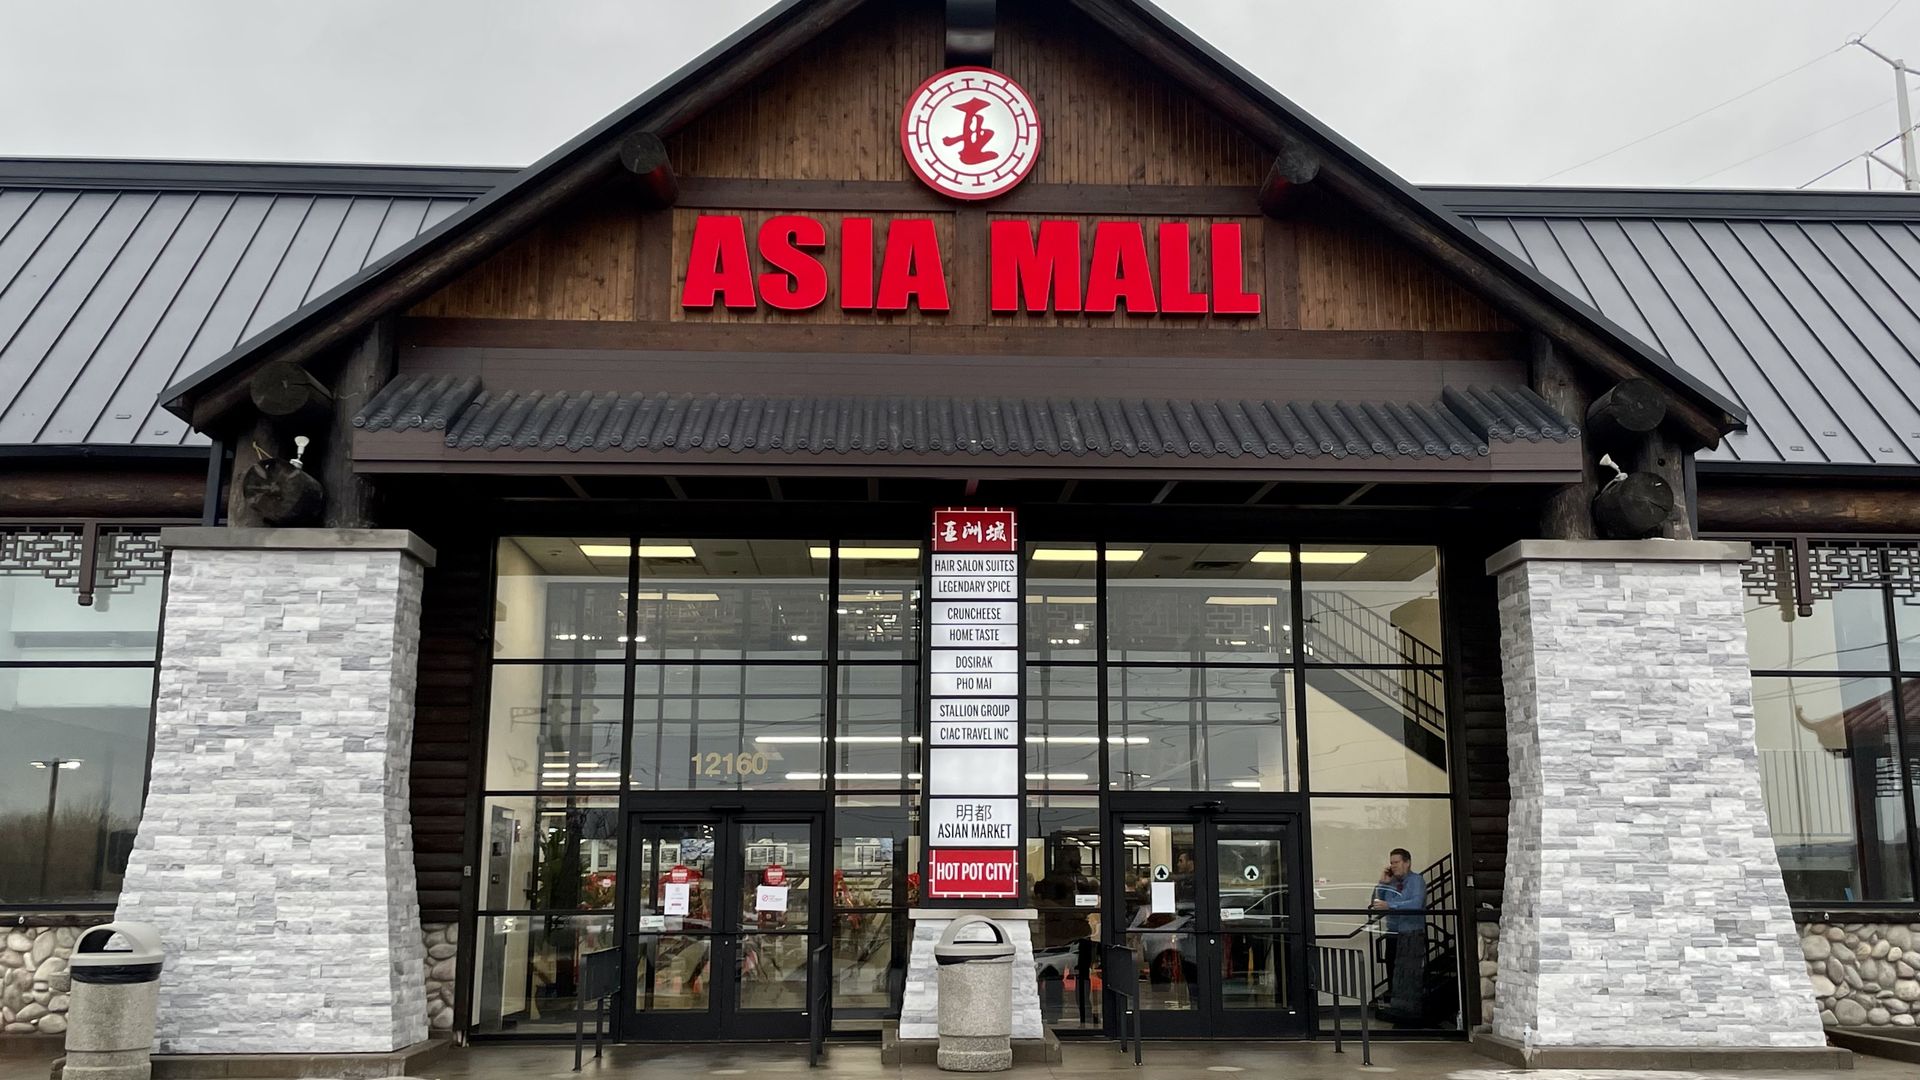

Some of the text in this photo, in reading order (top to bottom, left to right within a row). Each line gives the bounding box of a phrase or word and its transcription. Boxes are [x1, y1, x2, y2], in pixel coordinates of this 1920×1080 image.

[682, 215, 1261, 315] ASIA MALL
[934, 559, 1015, 572] HAIR SALON SUITES
[938, 580, 1011, 593] LEGENDARY SPICE
[947, 607, 1001, 620] CRUNCHEESE
[949, 628, 999, 641] HOME TASTE
[955, 655, 993, 669] DOSIRAK
[956, 677, 992, 690] PHO MAI
[939, 704, 1010, 718] STALLION GROUP
[940, 727, 1009, 740] CIAC TRAVEL INC
[691, 752, 768, 775] 12160
[956, 804, 992, 822] 明都
[937, 823, 1012, 839] ASIAN MARKET
[936, 862, 1012, 881] HOT POT CITY
